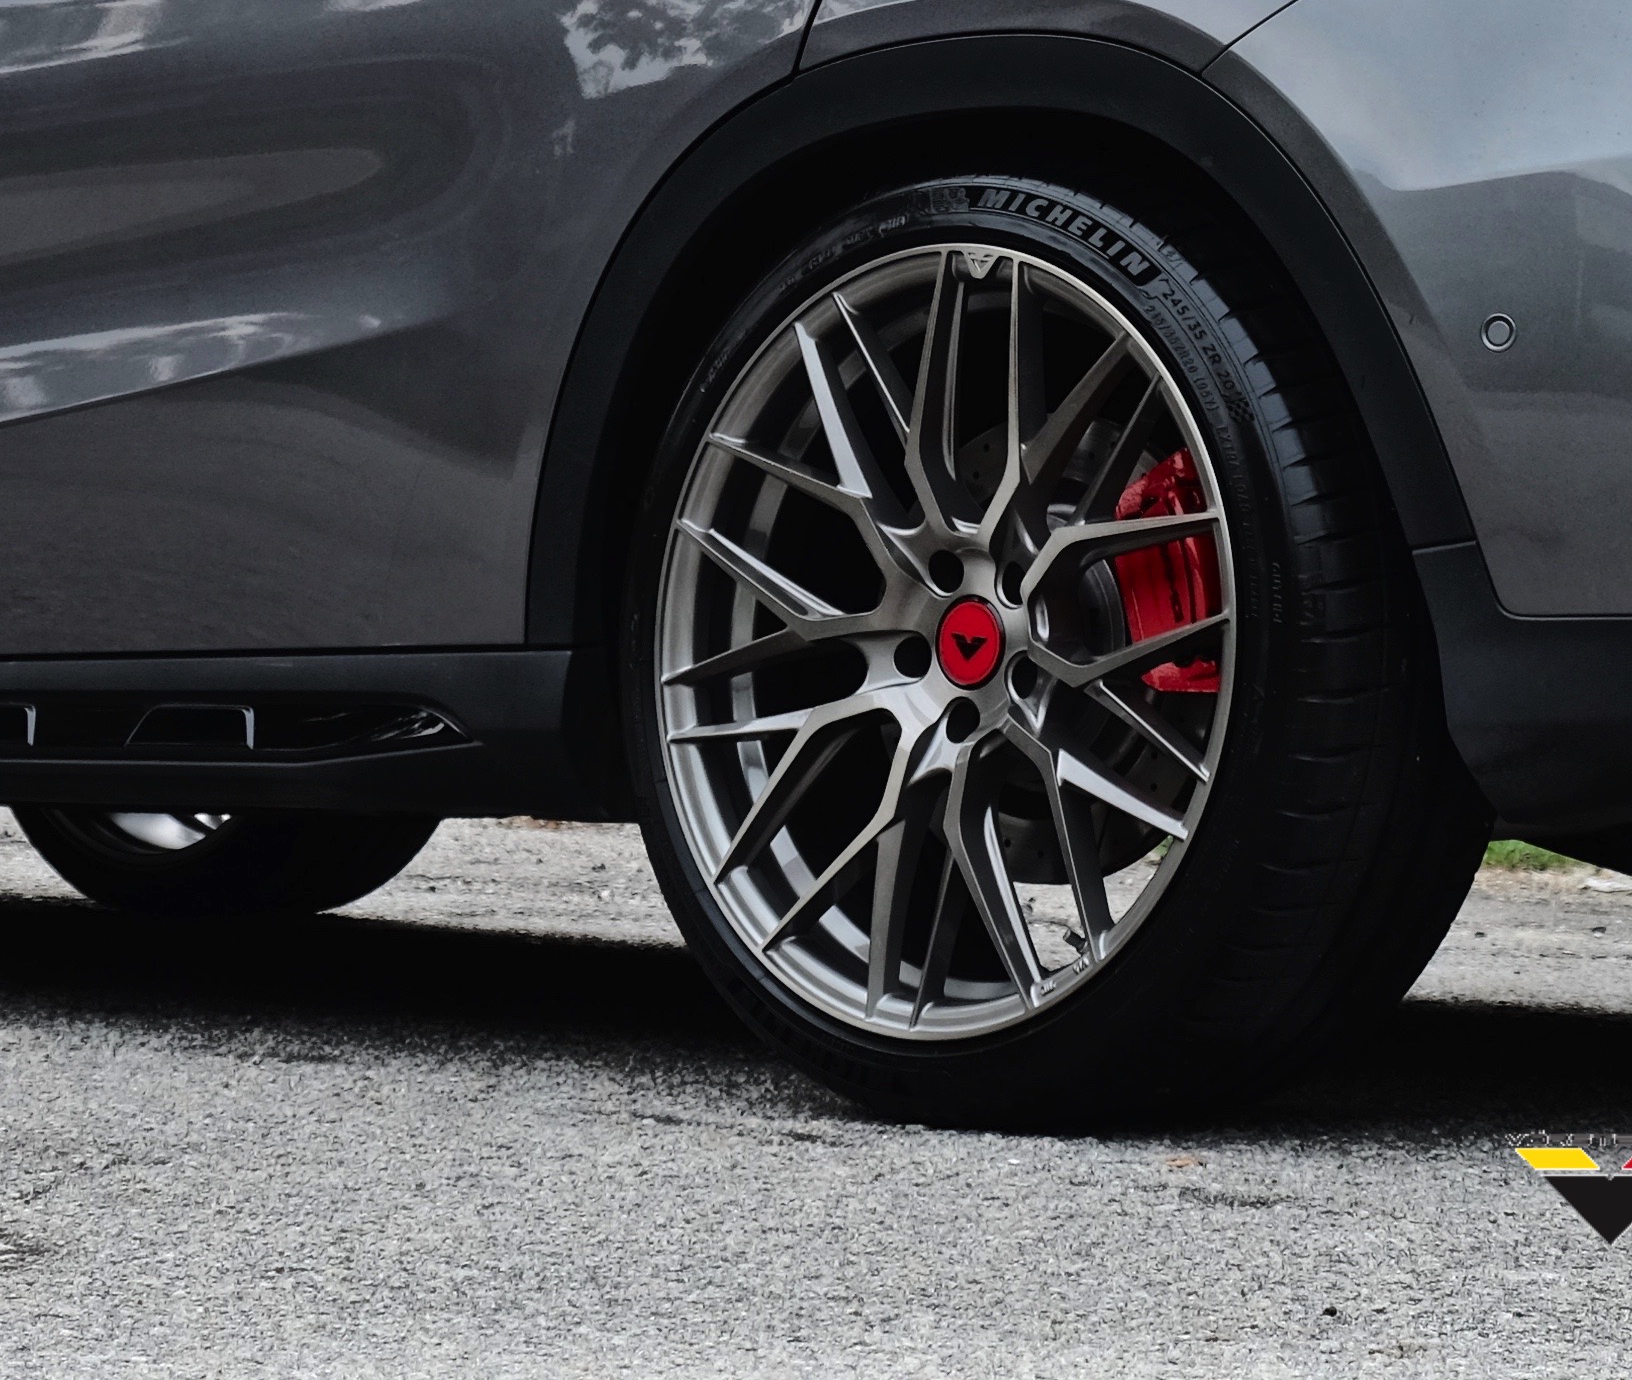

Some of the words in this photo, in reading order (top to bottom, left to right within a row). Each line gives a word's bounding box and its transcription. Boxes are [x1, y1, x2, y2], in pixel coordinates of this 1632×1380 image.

[977, 188, 1151, 276] MICHELIN
[1162, 287, 1208, 340] 245/35
[1202, 343, 1222, 365] ZR
[1217, 370, 1235, 390] 20
